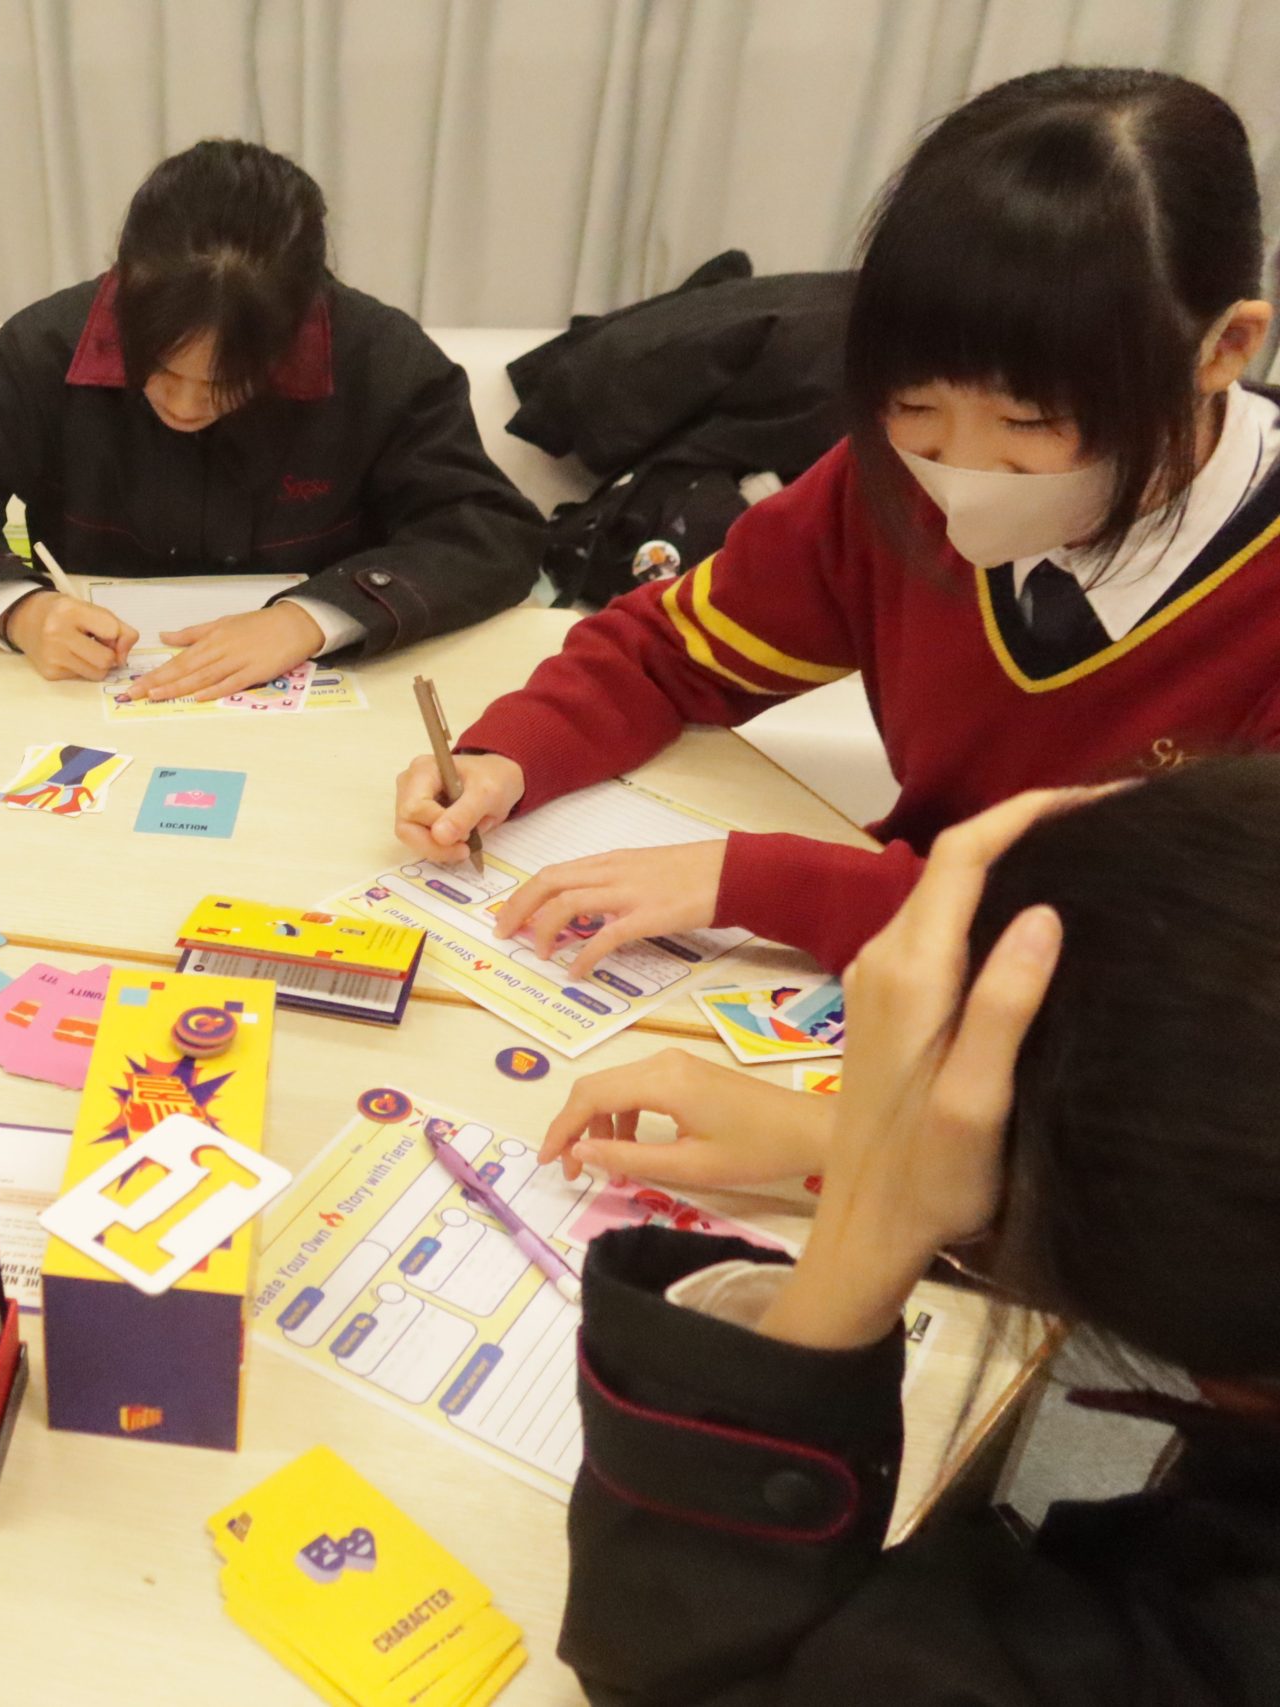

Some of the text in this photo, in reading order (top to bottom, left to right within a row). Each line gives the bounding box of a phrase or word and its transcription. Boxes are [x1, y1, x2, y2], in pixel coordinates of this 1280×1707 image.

[160, 822, 208, 831] LOCATION
[443, 941, 476, 961] Story
[494, 969, 521, 988] Own
[522, 986, 550, 1005] Your
[552, 1002, 595, 1029] Create
[276, 1252, 309, 1278] Your
[301, 1229, 332, 1253] Own
[336, 1186, 374, 1214] Story
[365, 1164, 392, 1186] with
[382, 1135, 417, 1165] Fiero!
[373, 1588, 454, 1653] CHARACTER
